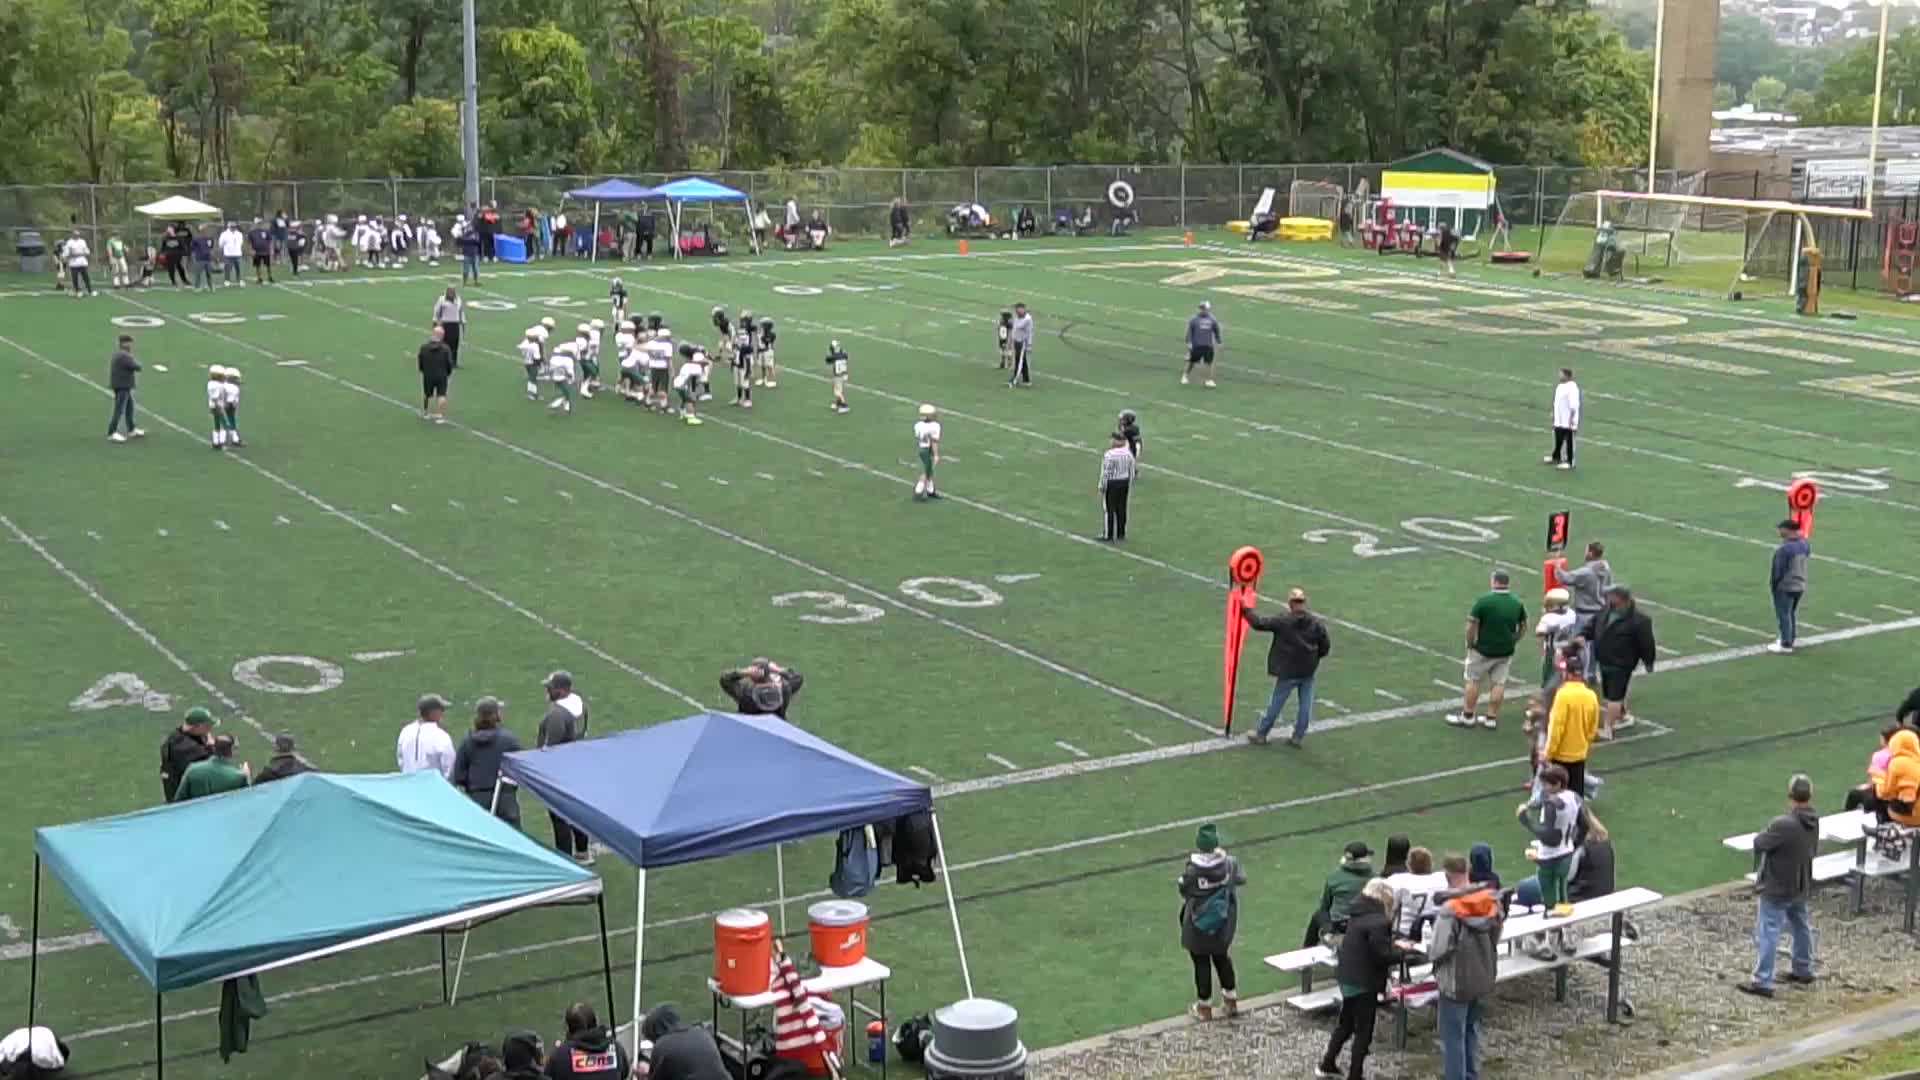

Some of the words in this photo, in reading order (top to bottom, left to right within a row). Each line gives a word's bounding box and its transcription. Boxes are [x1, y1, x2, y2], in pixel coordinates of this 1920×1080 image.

[1302, 517, 1500, 557] 20
[1551, 515, 1565, 542] 3
[772, 577, 1003, 624] 30
[68, 655, 344, 711] 40
